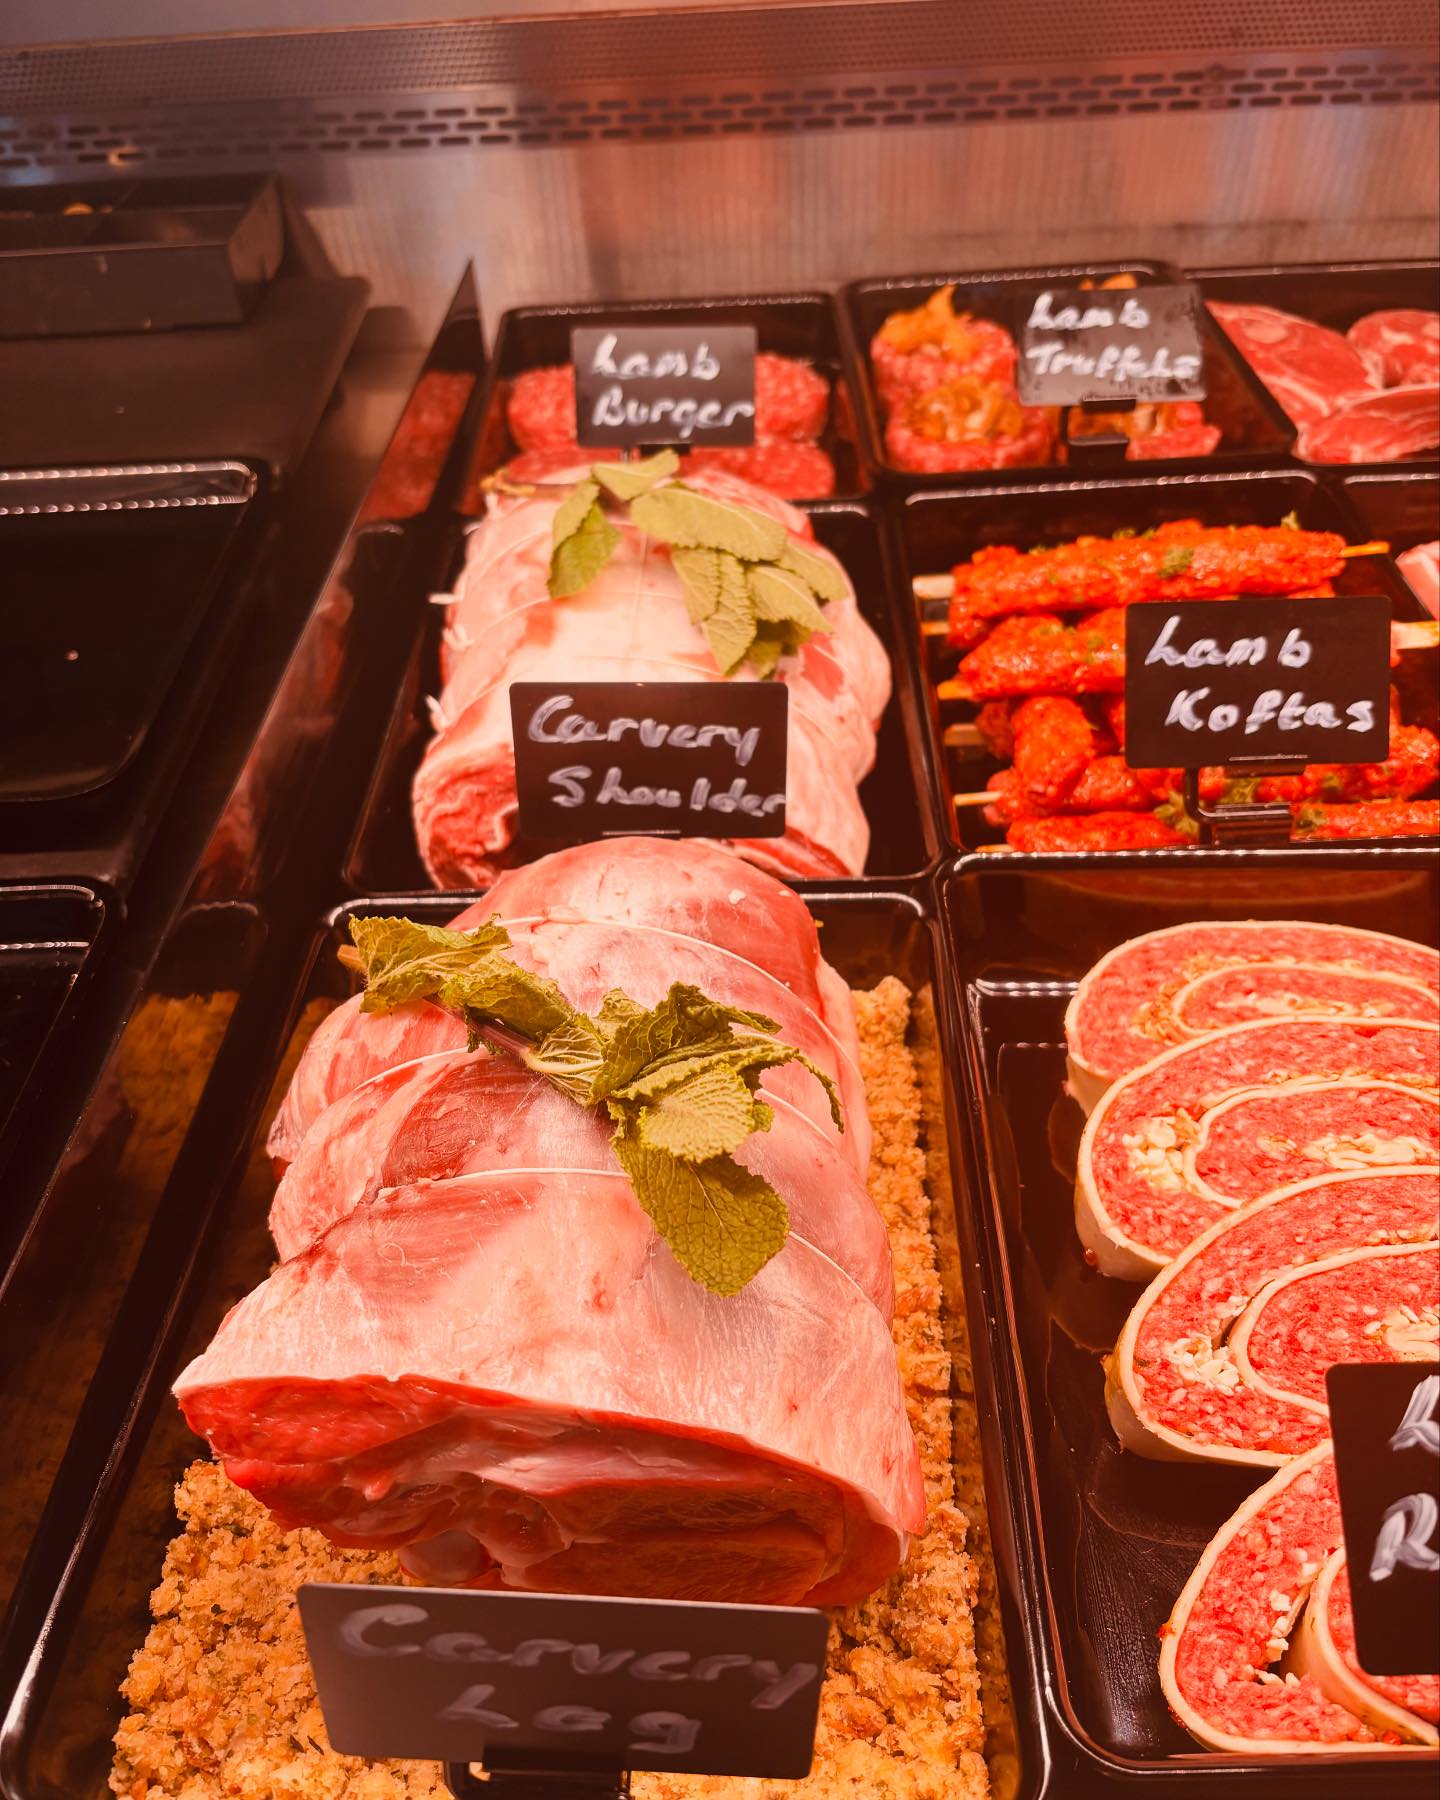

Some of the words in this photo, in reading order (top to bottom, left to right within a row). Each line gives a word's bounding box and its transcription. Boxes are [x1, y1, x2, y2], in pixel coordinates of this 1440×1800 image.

[1028, 292, 1150, 330] Lamb
[592, 333, 721, 381] Lamb
[592, 385, 756, 439] Burger
[1144, 615, 1312, 668] Lamb
[528, 694, 760, 766] Carvery
[1164, 686, 1375, 735] Koftas
[548, 765, 786, 817] Shoulder
[337, 1603, 818, 1709] Carvery
[437, 1683, 702, 1754] Leg
